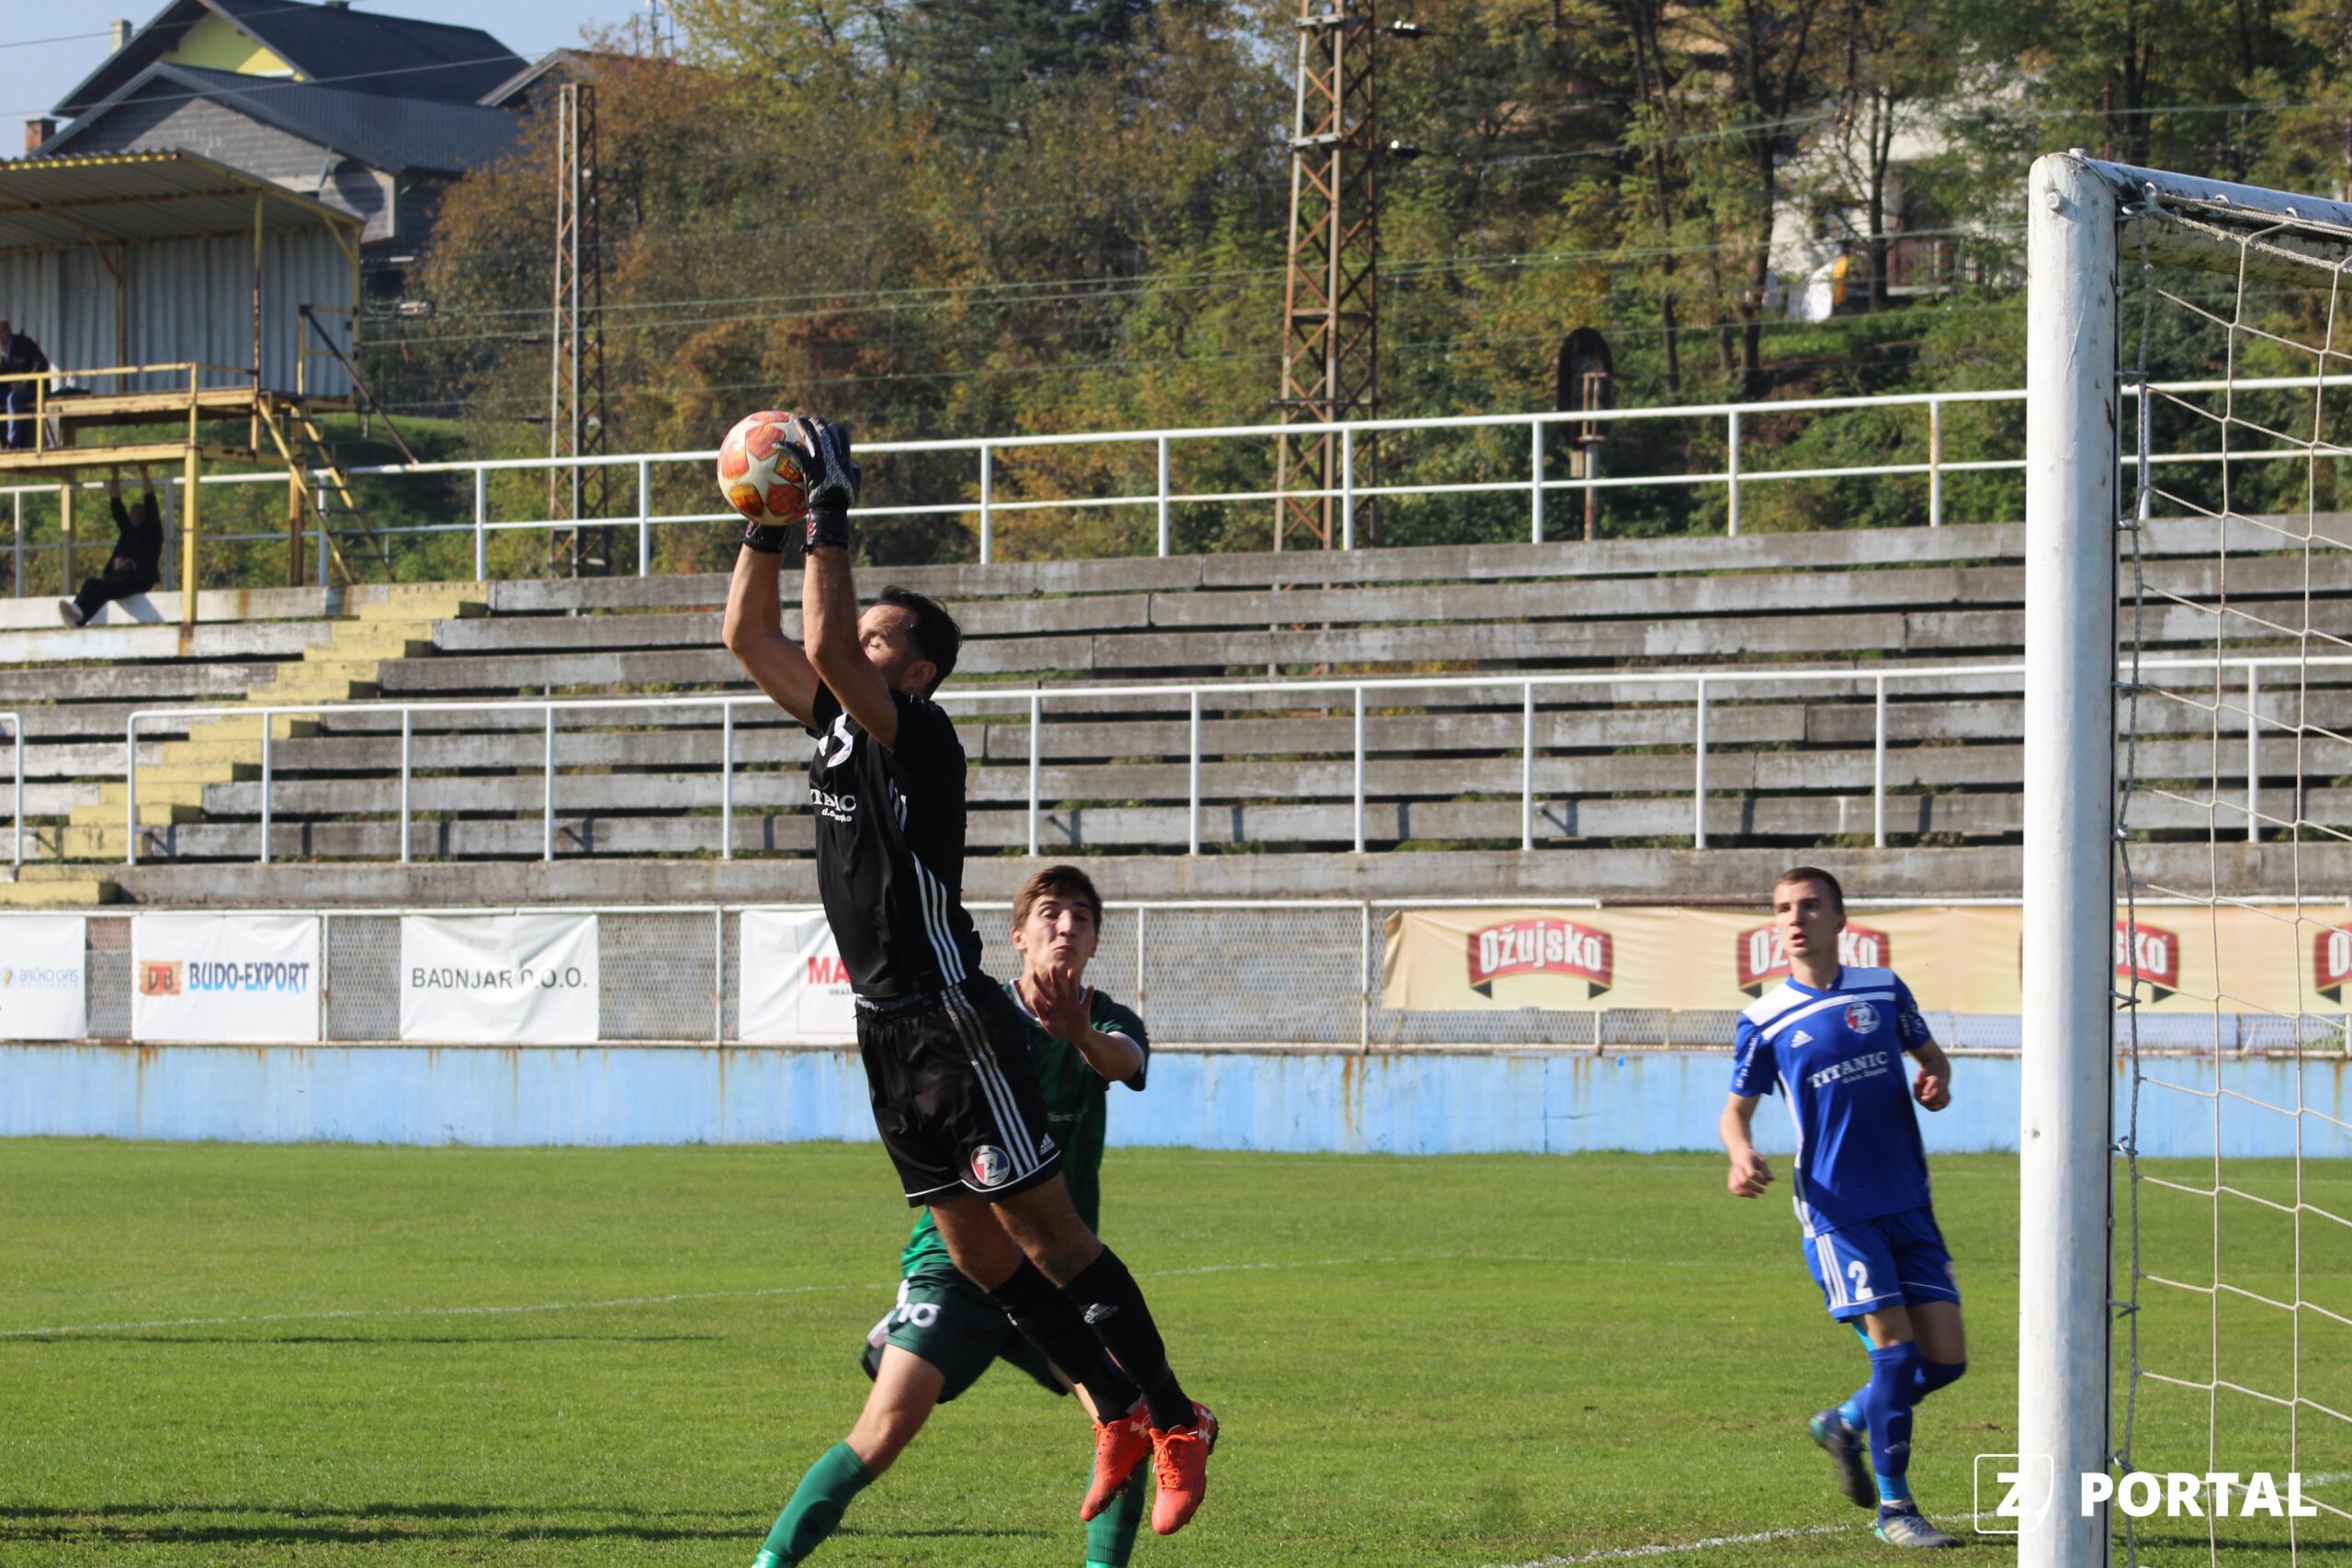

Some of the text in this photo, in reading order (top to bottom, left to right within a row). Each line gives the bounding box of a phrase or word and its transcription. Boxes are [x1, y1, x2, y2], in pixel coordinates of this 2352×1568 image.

[1479, 921, 1602, 974] Ožujsko
[189, 962, 310, 994] BUDO-EXPORT
[412, 967, 513, 989] BADNJAR
[1806, 1052, 1889, 1088] TITANIC
[1848, 1260, 1873, 1301] 2
